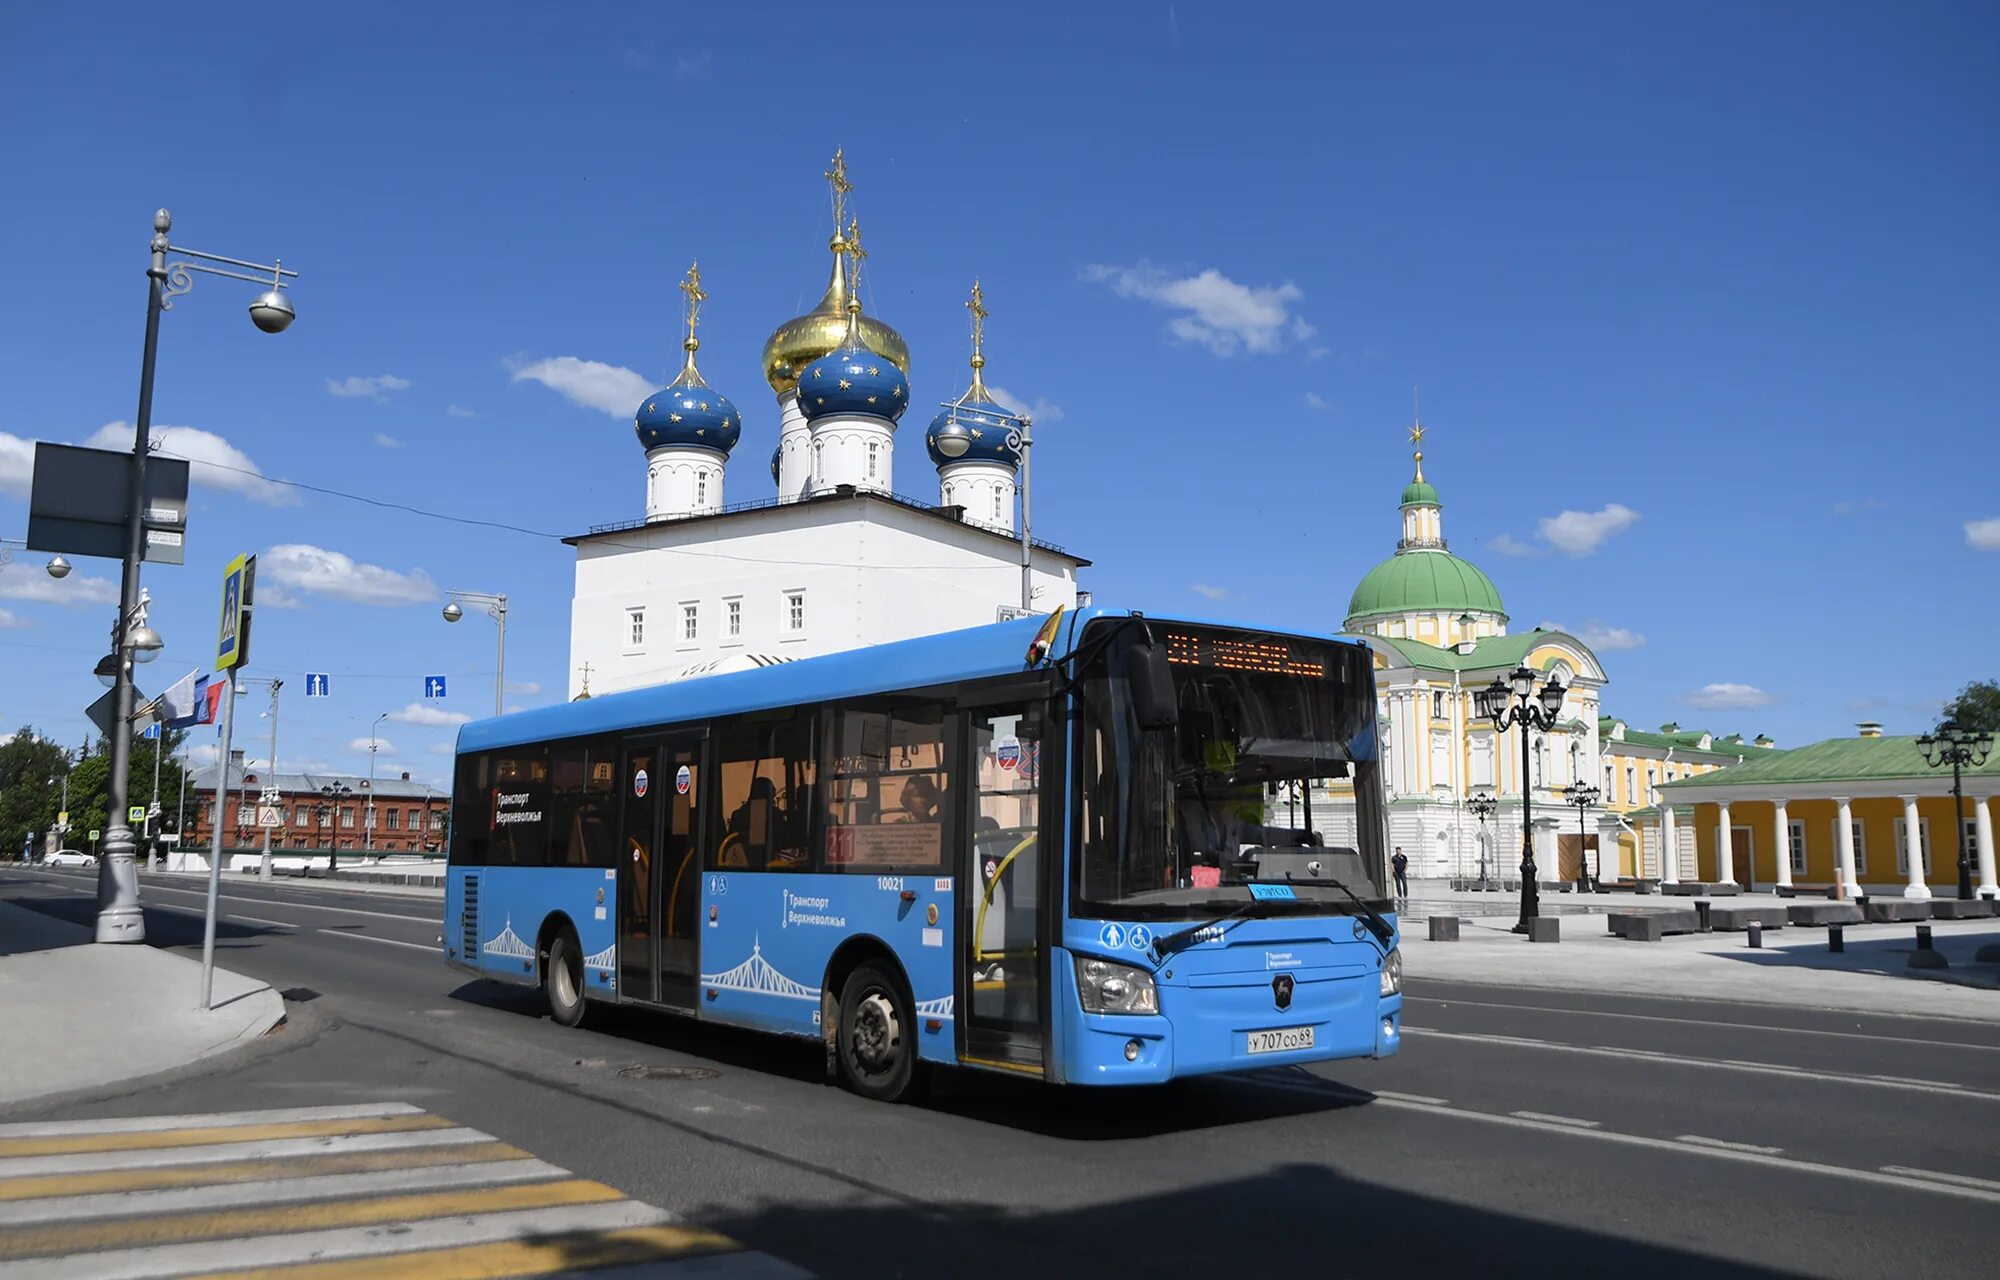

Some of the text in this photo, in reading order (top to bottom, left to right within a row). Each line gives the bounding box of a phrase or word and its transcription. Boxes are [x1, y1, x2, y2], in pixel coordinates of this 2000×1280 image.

[497, 793, 529, 808] Транспорт
[496, 811, 542, 826] Верхневолжья
[828, 832, 853, 858] 211
[877, 877, 904, 891] 10021
[789, 894, 829, 910] Транспорт
[788, 911, 846, 927] Верхневолжья
